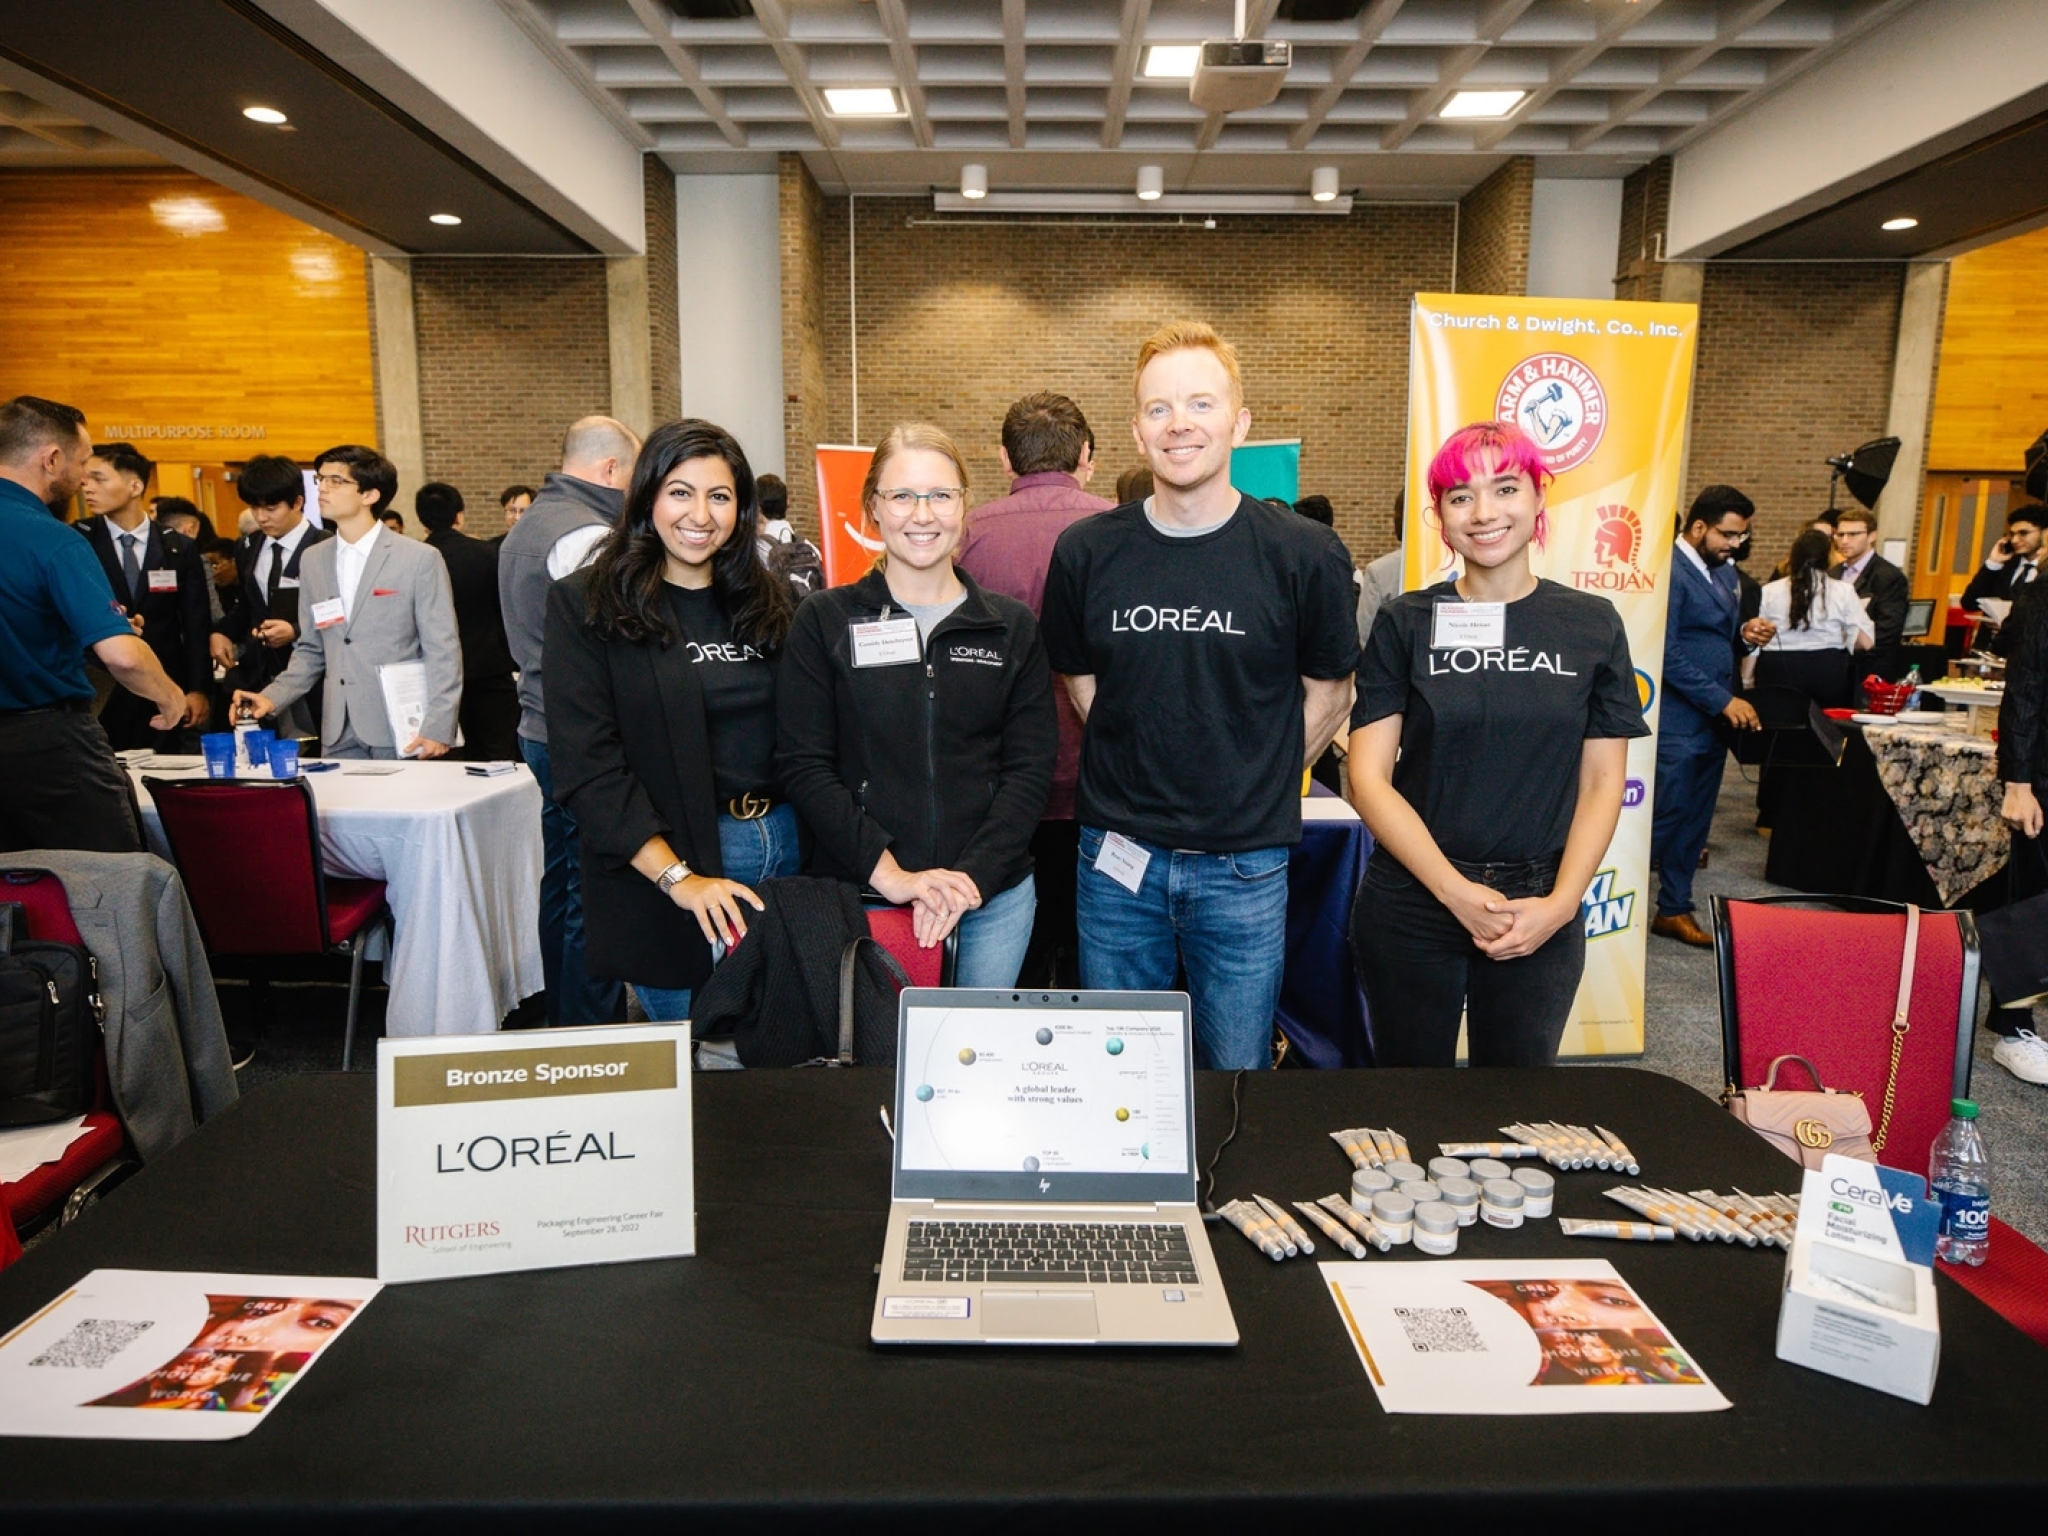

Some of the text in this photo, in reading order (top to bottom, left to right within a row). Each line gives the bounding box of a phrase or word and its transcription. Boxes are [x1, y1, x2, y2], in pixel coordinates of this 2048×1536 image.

[1430, 313, 1500, 329] Church
[1506, 316, 1520, 330] &
[1650, 321, 1684, 337] Inc.
[1500, 358, 1601, 425] ARM & HAMMER
[104, 425, 266, 439] MULTIPURPOSE ROOM
[1571, 571, 1657, 591] TROJAN
[1112, 605, 1246, 636] L'ORÉAL
[1428, 646, 1578, 676] L'ORÉAL
[446, 1061, 629, 1087] Bronze Sponsor
[1007, 1094, 1084, 1105] with strong values
[1014, 1085, 1077, 1095] A global leader
[437, 1130, 636, 1174] L'ORÉAL
[1830, 1177, 1914, 1214] CeraVe
[536, 1209, 664, 1228] Packaging Engineering Career Fair
[1955, 1209, 1989, 1226] 100
[405, 1221, 501, 1248] RUTGERS
[562, 1227, 604, 1238] September
[620, 1223, 640, 1232] 2022
[469, 1240, 512, 1252] Engineering
